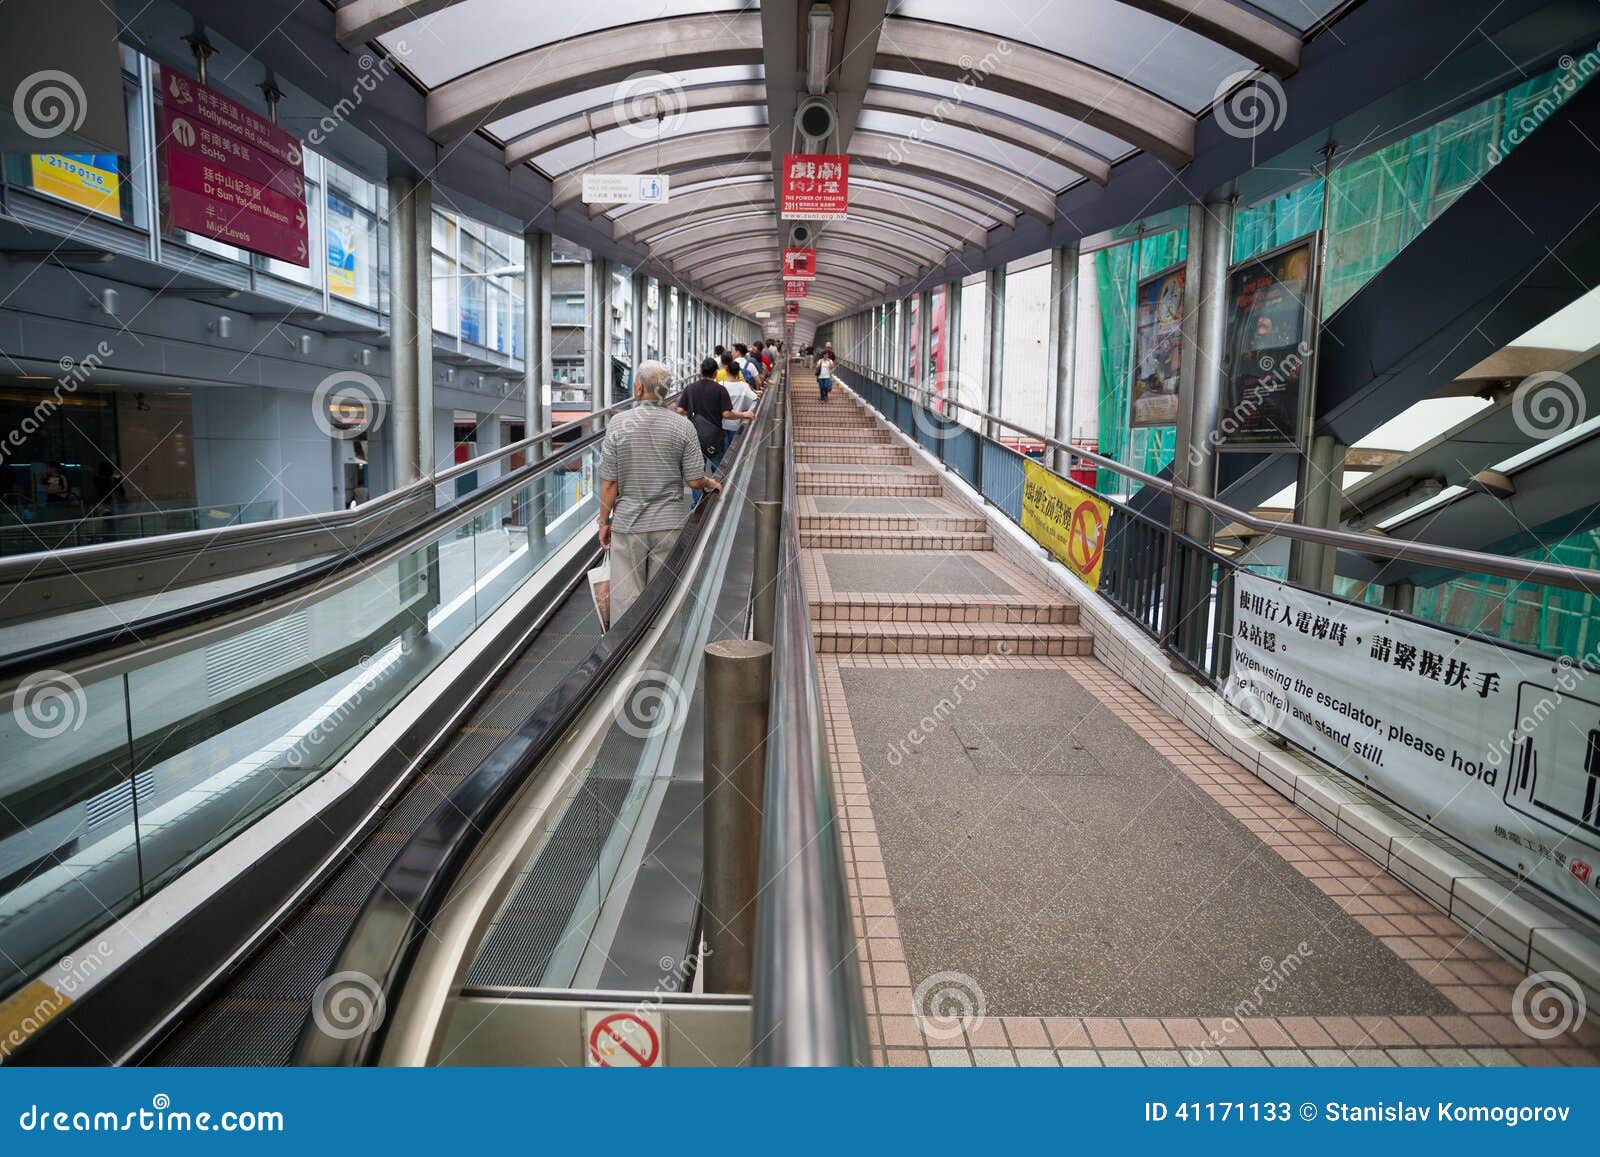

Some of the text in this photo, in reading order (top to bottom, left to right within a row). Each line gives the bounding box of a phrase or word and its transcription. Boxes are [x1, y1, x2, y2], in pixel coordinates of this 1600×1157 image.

[198, 104, 243, 134] Hollywood
[244, 129, 255, 140] Rd
[48, 156, 104, 184] 2119 0116
[200, 144, 226, 162] SoHo
[203, 166, 261, 200] 孫中山紀念館
[203, 183, 289, 224] Dr Sun Yat-sen Museum
[784, 202, 799, 210] 2011
[206, 220, 251, 242] Mid-Levels
[1238, 620, 1288, 653] 及站穩。
[1240, 589, 1501, 698] 使用行人電梯時，請緊握扶手
[1235, 649, 1498, 787] When using the escalator, please hold
[1249, 680, 1290, 713] handrail
[1292, 707, 1313, 726] and
[1313, 720, 1351, 748] stand
[1353, 740, 1385, 768] still.
